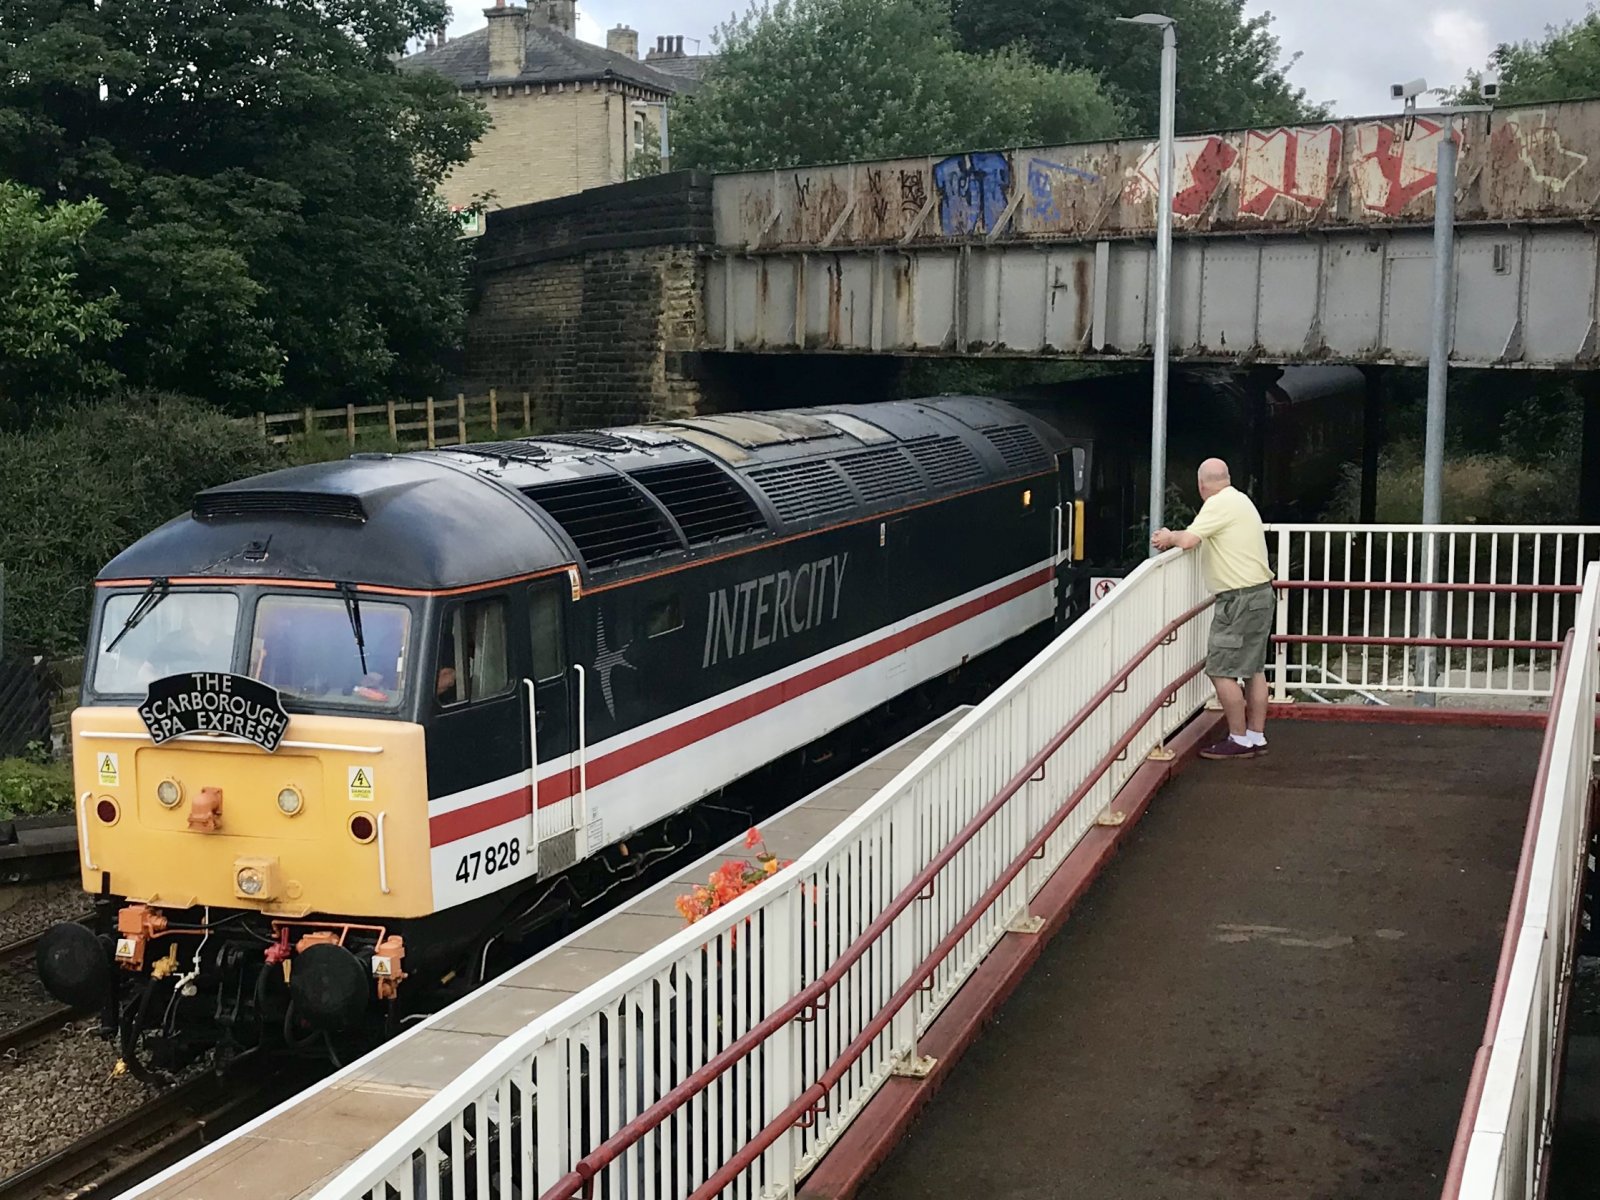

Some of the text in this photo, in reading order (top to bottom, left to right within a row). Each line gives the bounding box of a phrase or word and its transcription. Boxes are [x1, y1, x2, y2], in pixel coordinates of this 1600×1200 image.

[702, 551, 849, 668] INTERCITY
[192, 673, 232, 693] THE
[141, 692, 287, 734] SCARBOROUGH
[151, 711, 277, 749] SPA EXPRESS
[456, 837, 520, 884] 47828
